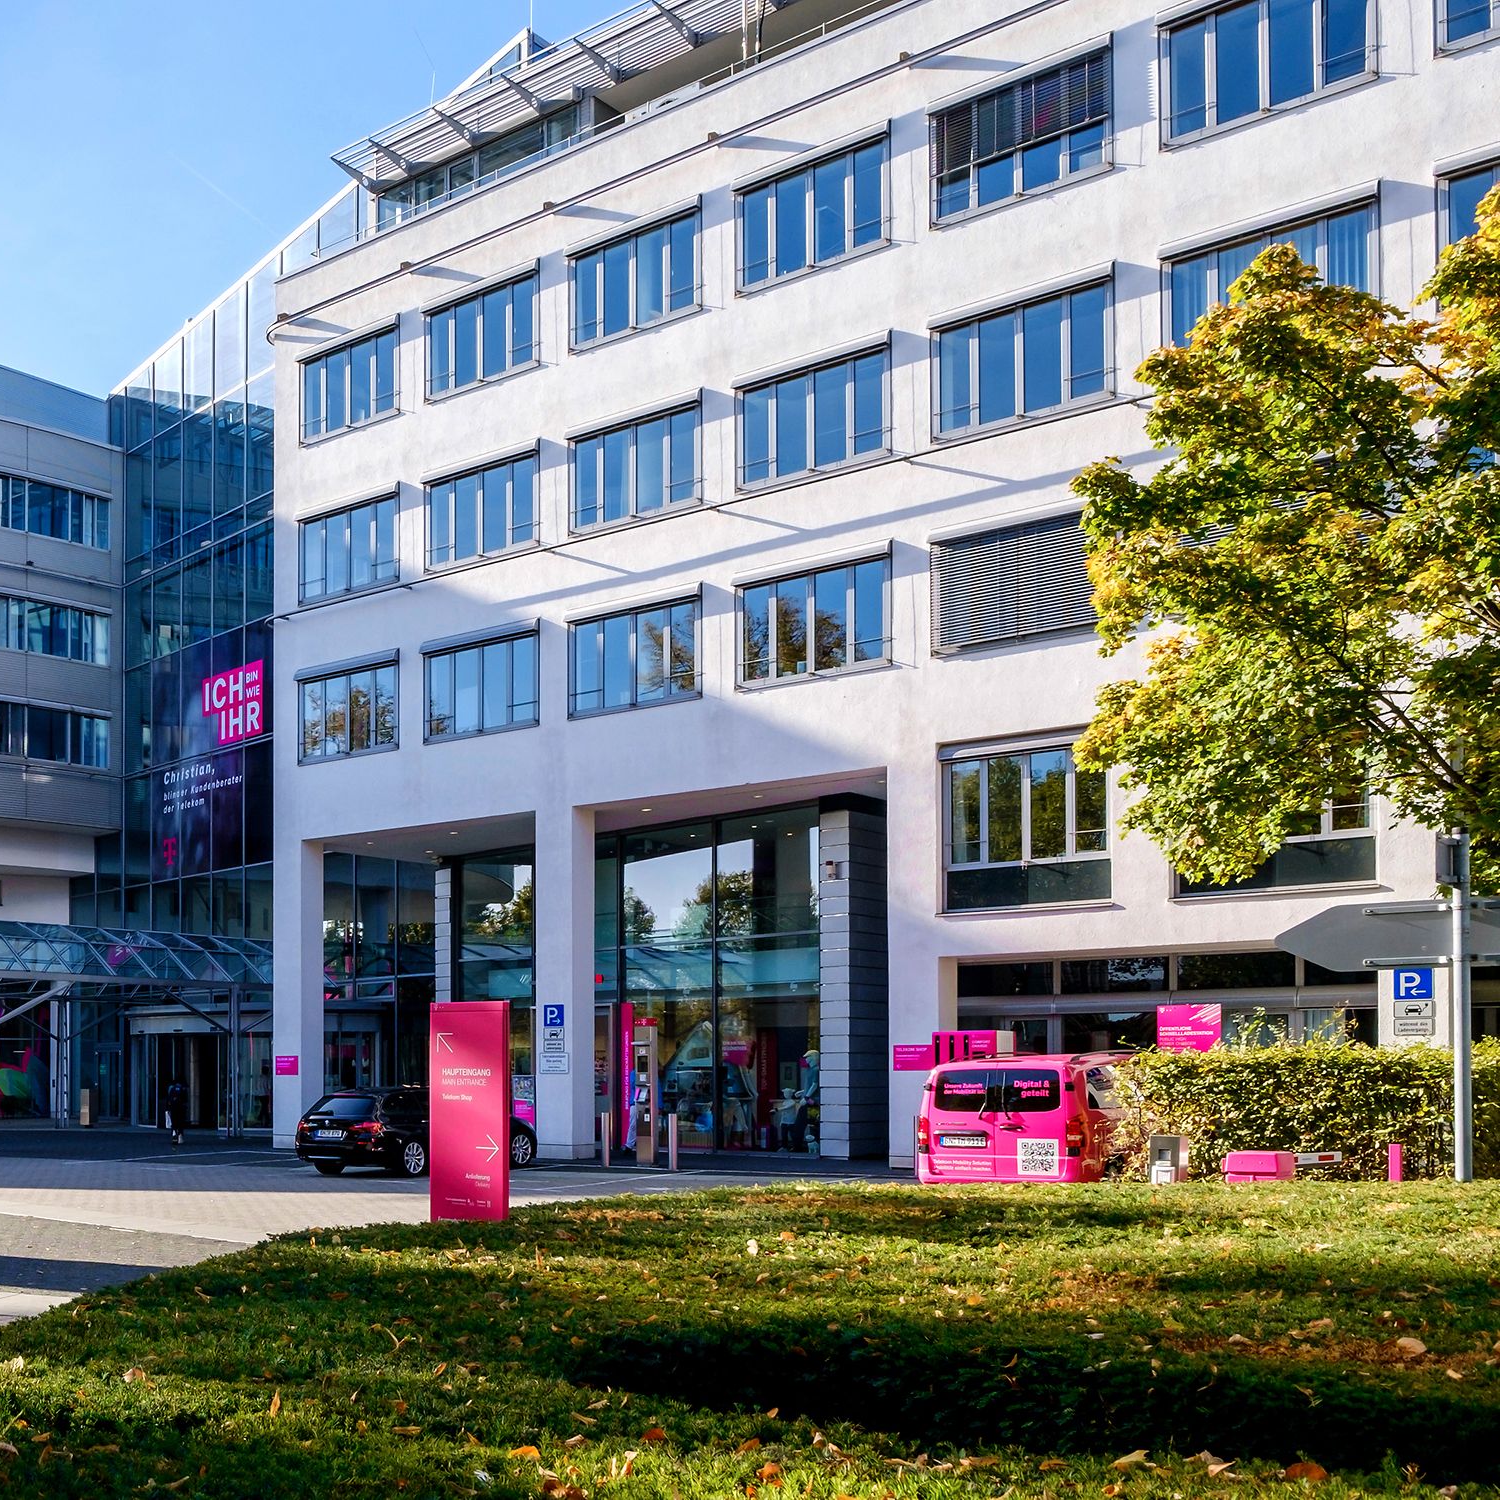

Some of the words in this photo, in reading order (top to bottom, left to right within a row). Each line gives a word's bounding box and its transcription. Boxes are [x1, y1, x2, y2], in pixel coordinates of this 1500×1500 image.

[245, 670, 259, 684] BIN
[204, 671, 244, 712] ICH
[245, 684, 260, 699] WIE
[220, 701, 260, 740] IHR
[163, 763, 215, 785] Christian,
[1400, 972, 1421, 997] P
[546, 1007, 559, 1025] P
[442, 1068, 491, 1076] HAUPTEINGANG
[456, 1078, 487, 1086] ENTRANCE
[1013, 1080, 1042, 1089] Digital
[1043, 1080, 1050, 1088] &
[1020, 1089, 1050, 1098] geteilt
